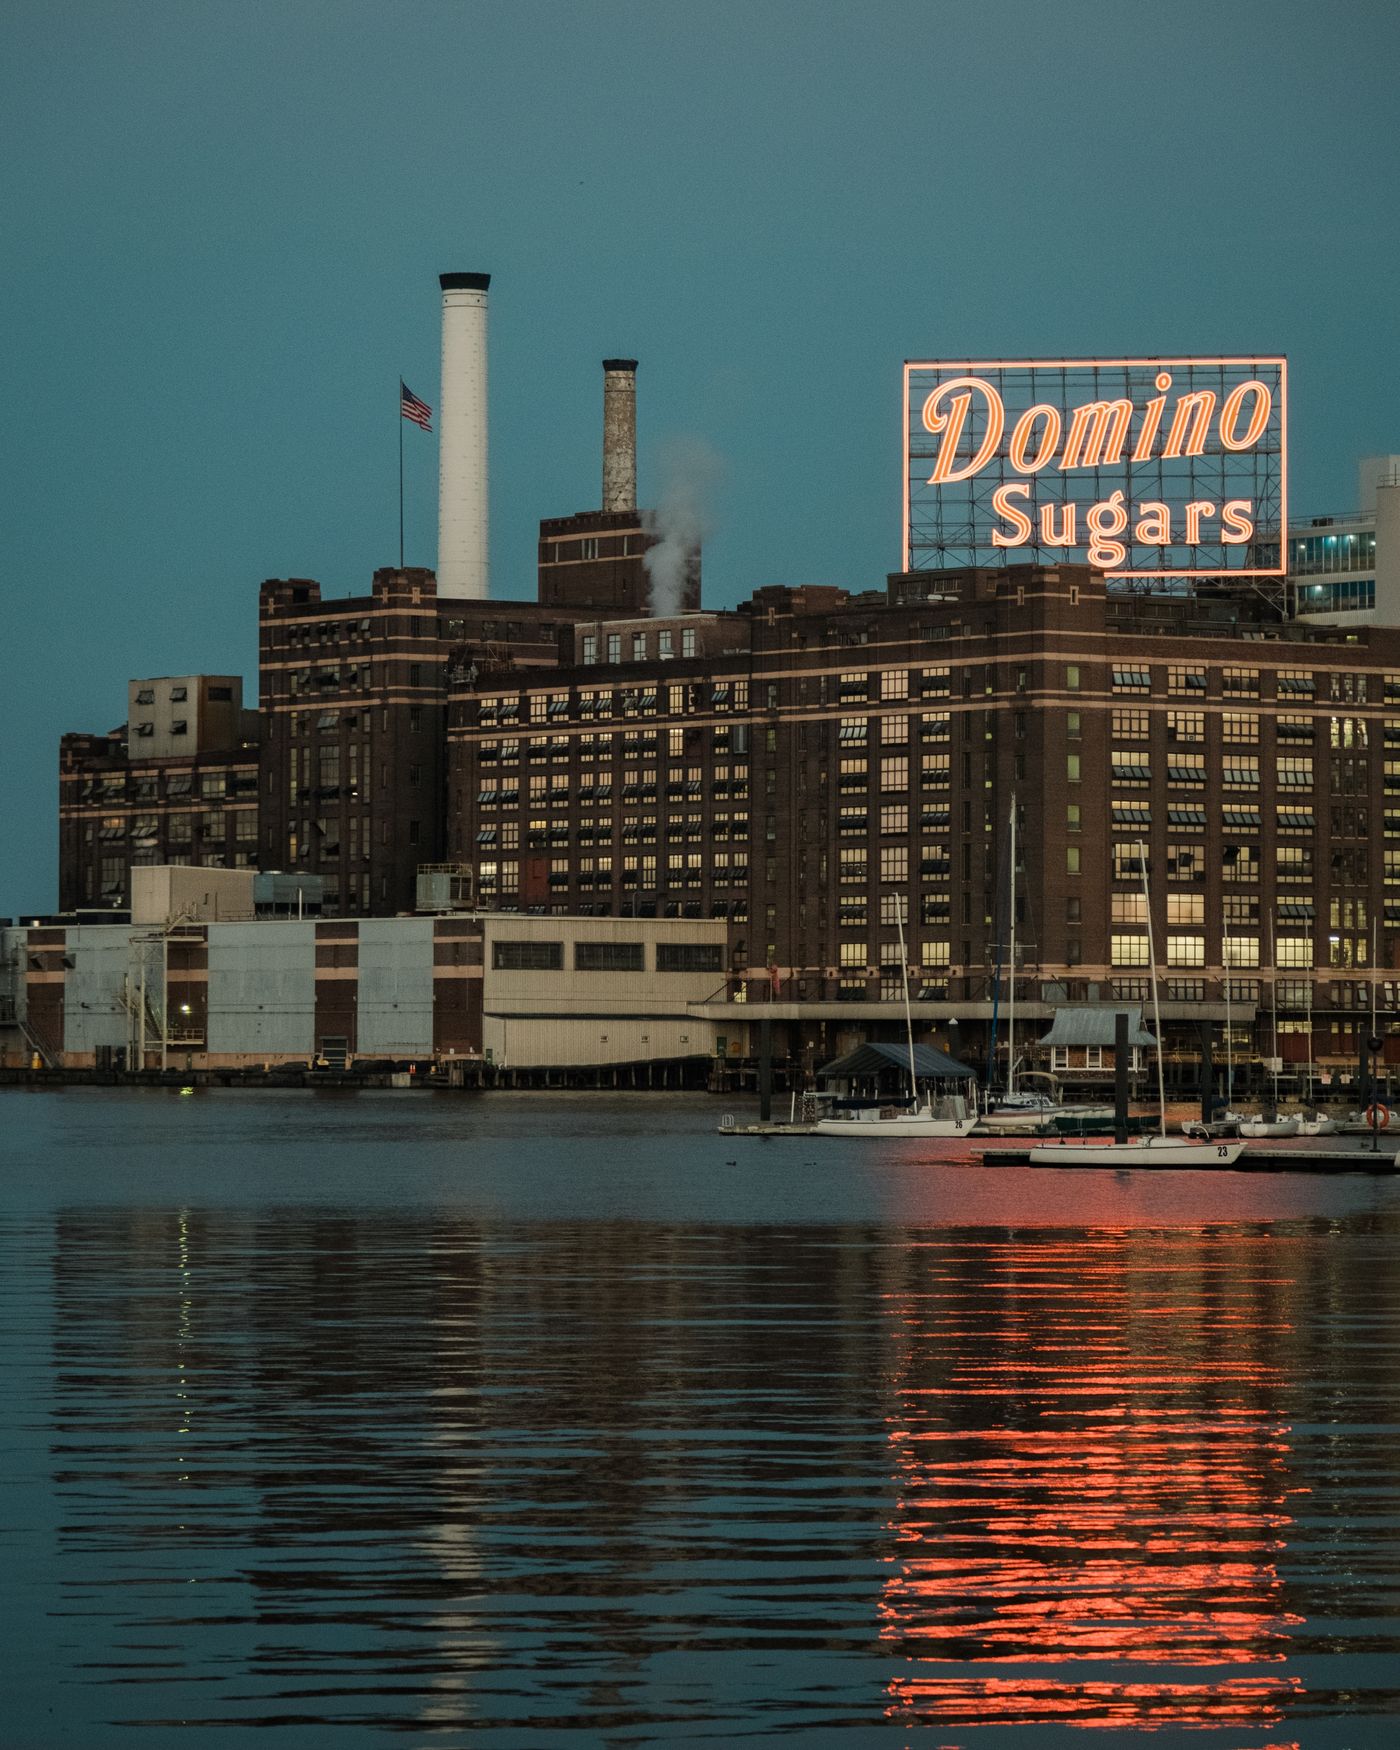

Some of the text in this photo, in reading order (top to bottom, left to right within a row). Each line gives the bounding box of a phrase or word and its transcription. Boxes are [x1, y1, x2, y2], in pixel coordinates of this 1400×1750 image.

[922, 372, 1272, 485] Domino
[991, 483, 1254, 568] Sugars
[955, 1120, 963, 1129] 26
[1217, 1146, 1228, 1157] 23
